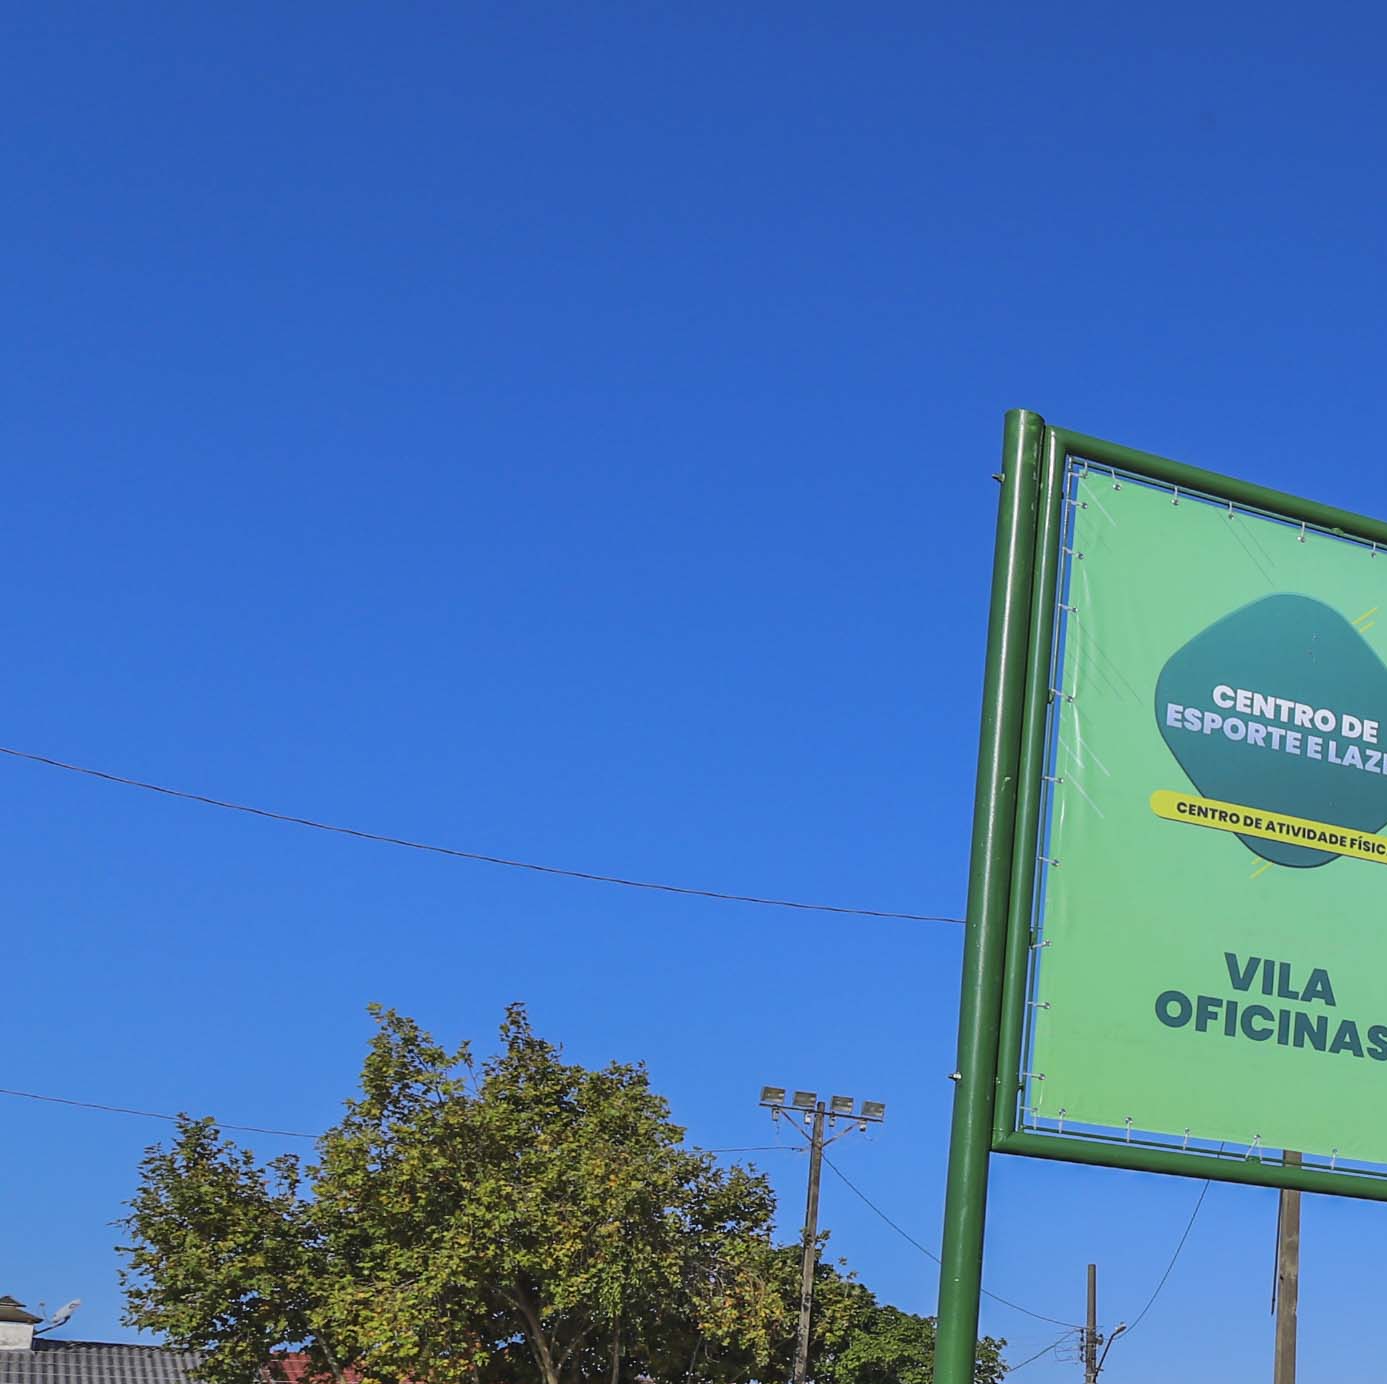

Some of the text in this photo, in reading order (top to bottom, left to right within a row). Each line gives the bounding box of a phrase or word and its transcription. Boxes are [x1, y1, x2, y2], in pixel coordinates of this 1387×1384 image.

[1166, 703, 1303, 756] ESPORTE
[1306, 736, 1323, 760] E
[1212, 685, 1379, 744] CENTRO DE
[1176, 802, 1240, 824] CENTRO
[1243, 815, 1263, 830] DE
[1265, 821, 1348, 847] ATIVIDADE
[1224, 951, 1336, 1007] VILA
